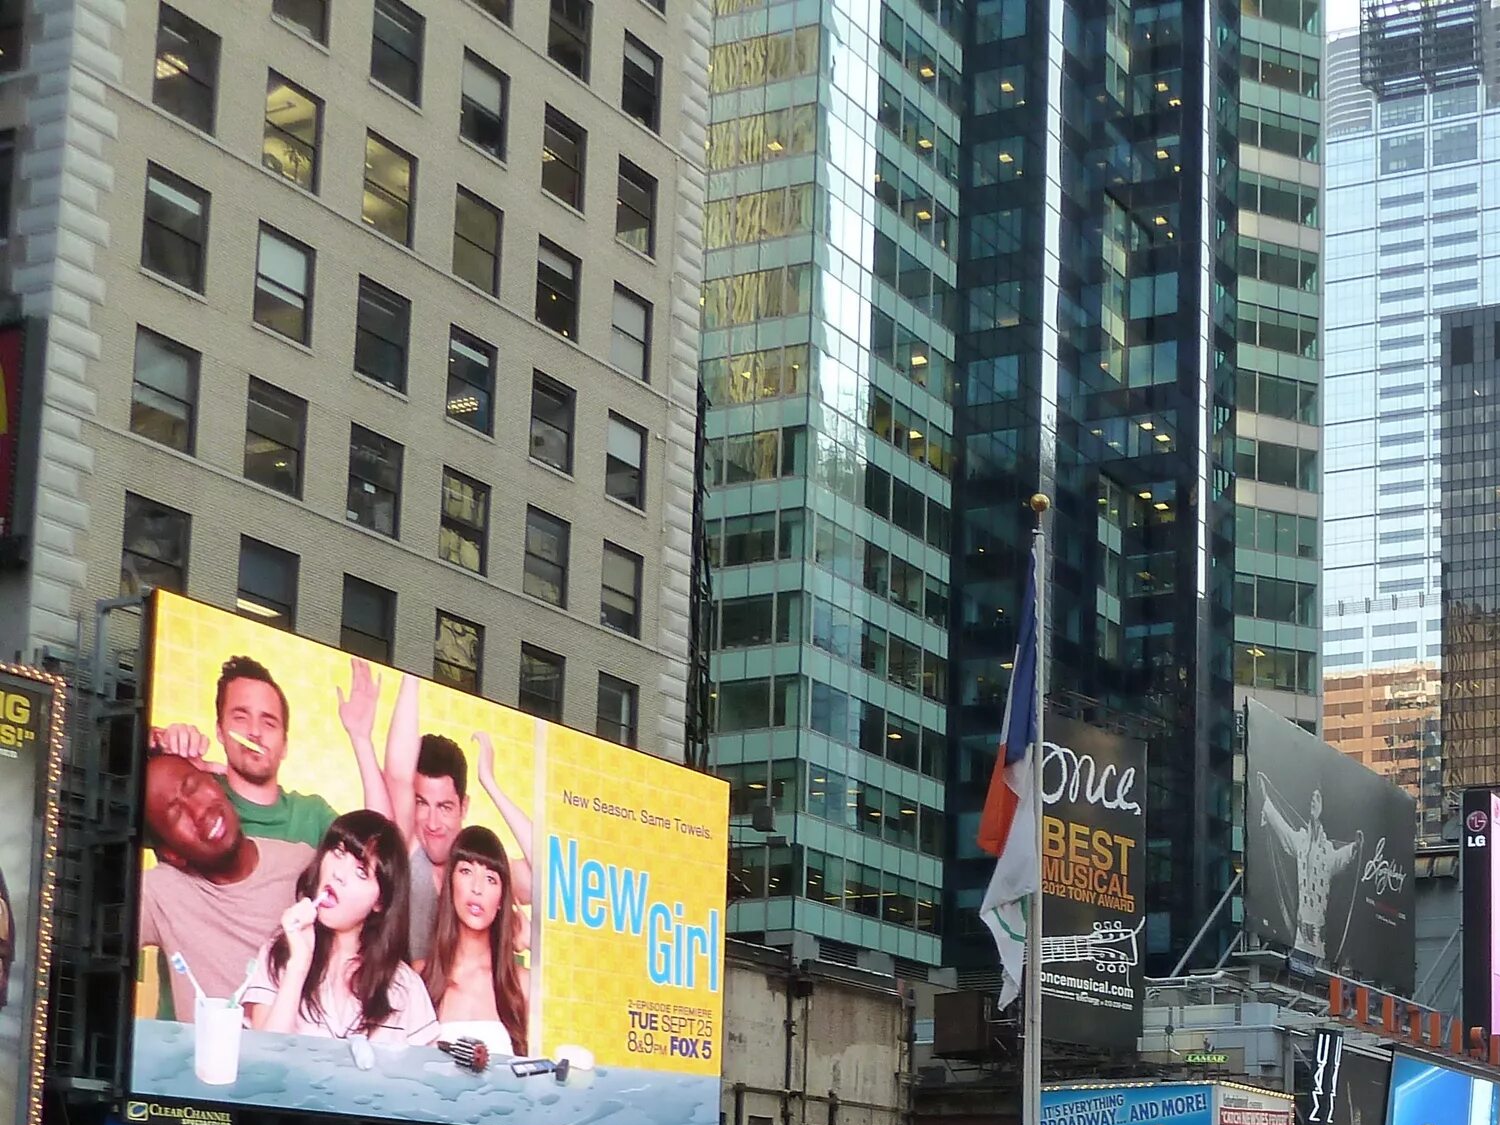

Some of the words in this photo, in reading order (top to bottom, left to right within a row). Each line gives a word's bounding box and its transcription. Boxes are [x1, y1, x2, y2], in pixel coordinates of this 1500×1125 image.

[563, 790, 589, 809] New
[592, 798, 637, 821] Season.
[640, 810, 671, 829] Same
[674, 818, 713, 840] Towels.
[1043, 816, 1136, 876] BEST
[1467, 834, 1486, 848] LG
[547, 833, 650, 937] New
[1043, 856, 1135, 900] MUSICAL
[1043, 880, 1067, 897] 2012
[1068, 886, 1097, 907] TONY
[1098, 894, 1135, 914] AWARD
[647, 902, 719, 993] Girl
[1040, 971, 1134, 999] oncemusical.com
[628, 1011, 658, 1031] TUE
[661, 1014, 696, 1034] SEPT
[697, 1019, 712, 1037] 25
[673, 1006, 712, 1019] PREMIERE
[669, 1036, 699, 1059] FOX
[701, 1040, 712, 1060] 5
[1188, 1054, 1225, 1063] LAMAR
[1043, 1105, 1061, 1119] IT'S
[1062, 1094, 1125, 1115] EVERYTHING
[1130, 1102, 1159, 1122] AND
[1162, 1093, 1207, 1117] MORE!
